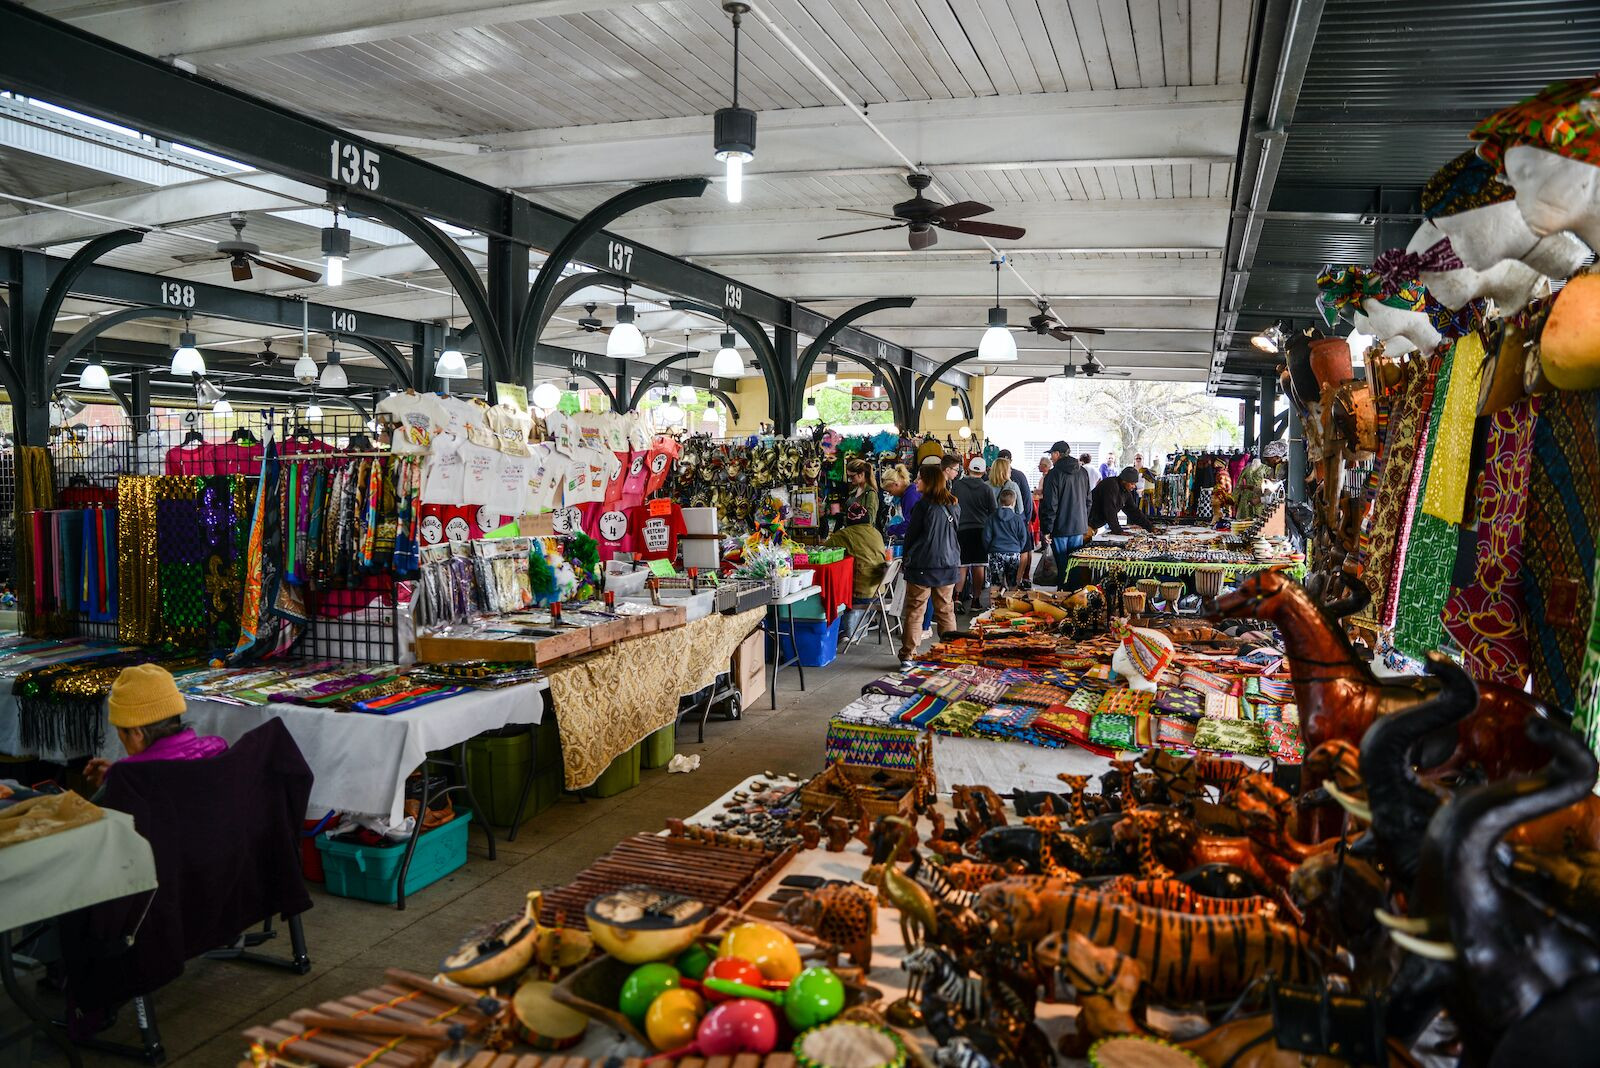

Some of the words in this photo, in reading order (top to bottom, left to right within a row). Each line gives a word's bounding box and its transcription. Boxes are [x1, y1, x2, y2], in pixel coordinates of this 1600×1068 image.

[331, 140, 380, 190] 135
[609, 241, 633, 273] 137
[161, 282, 195, 307] 138
[726, 284, 742, 309] 139
[332, 311, 356, 332] 140
[572, 353, 587, 368] 144
[658, 370, 669, 380] 146
[709, 377, 719, 389] 148
[633, 463, 639, 472] 2
[486, 519, 491, 528] 1
[604, 514, 624, 523] SEXY
[447, 521, 468, 532] TROUBLE
[562, 520, 569, 530] 3
[429, 530, 435, 540] 3
[610, 526, 616, 536] 4
